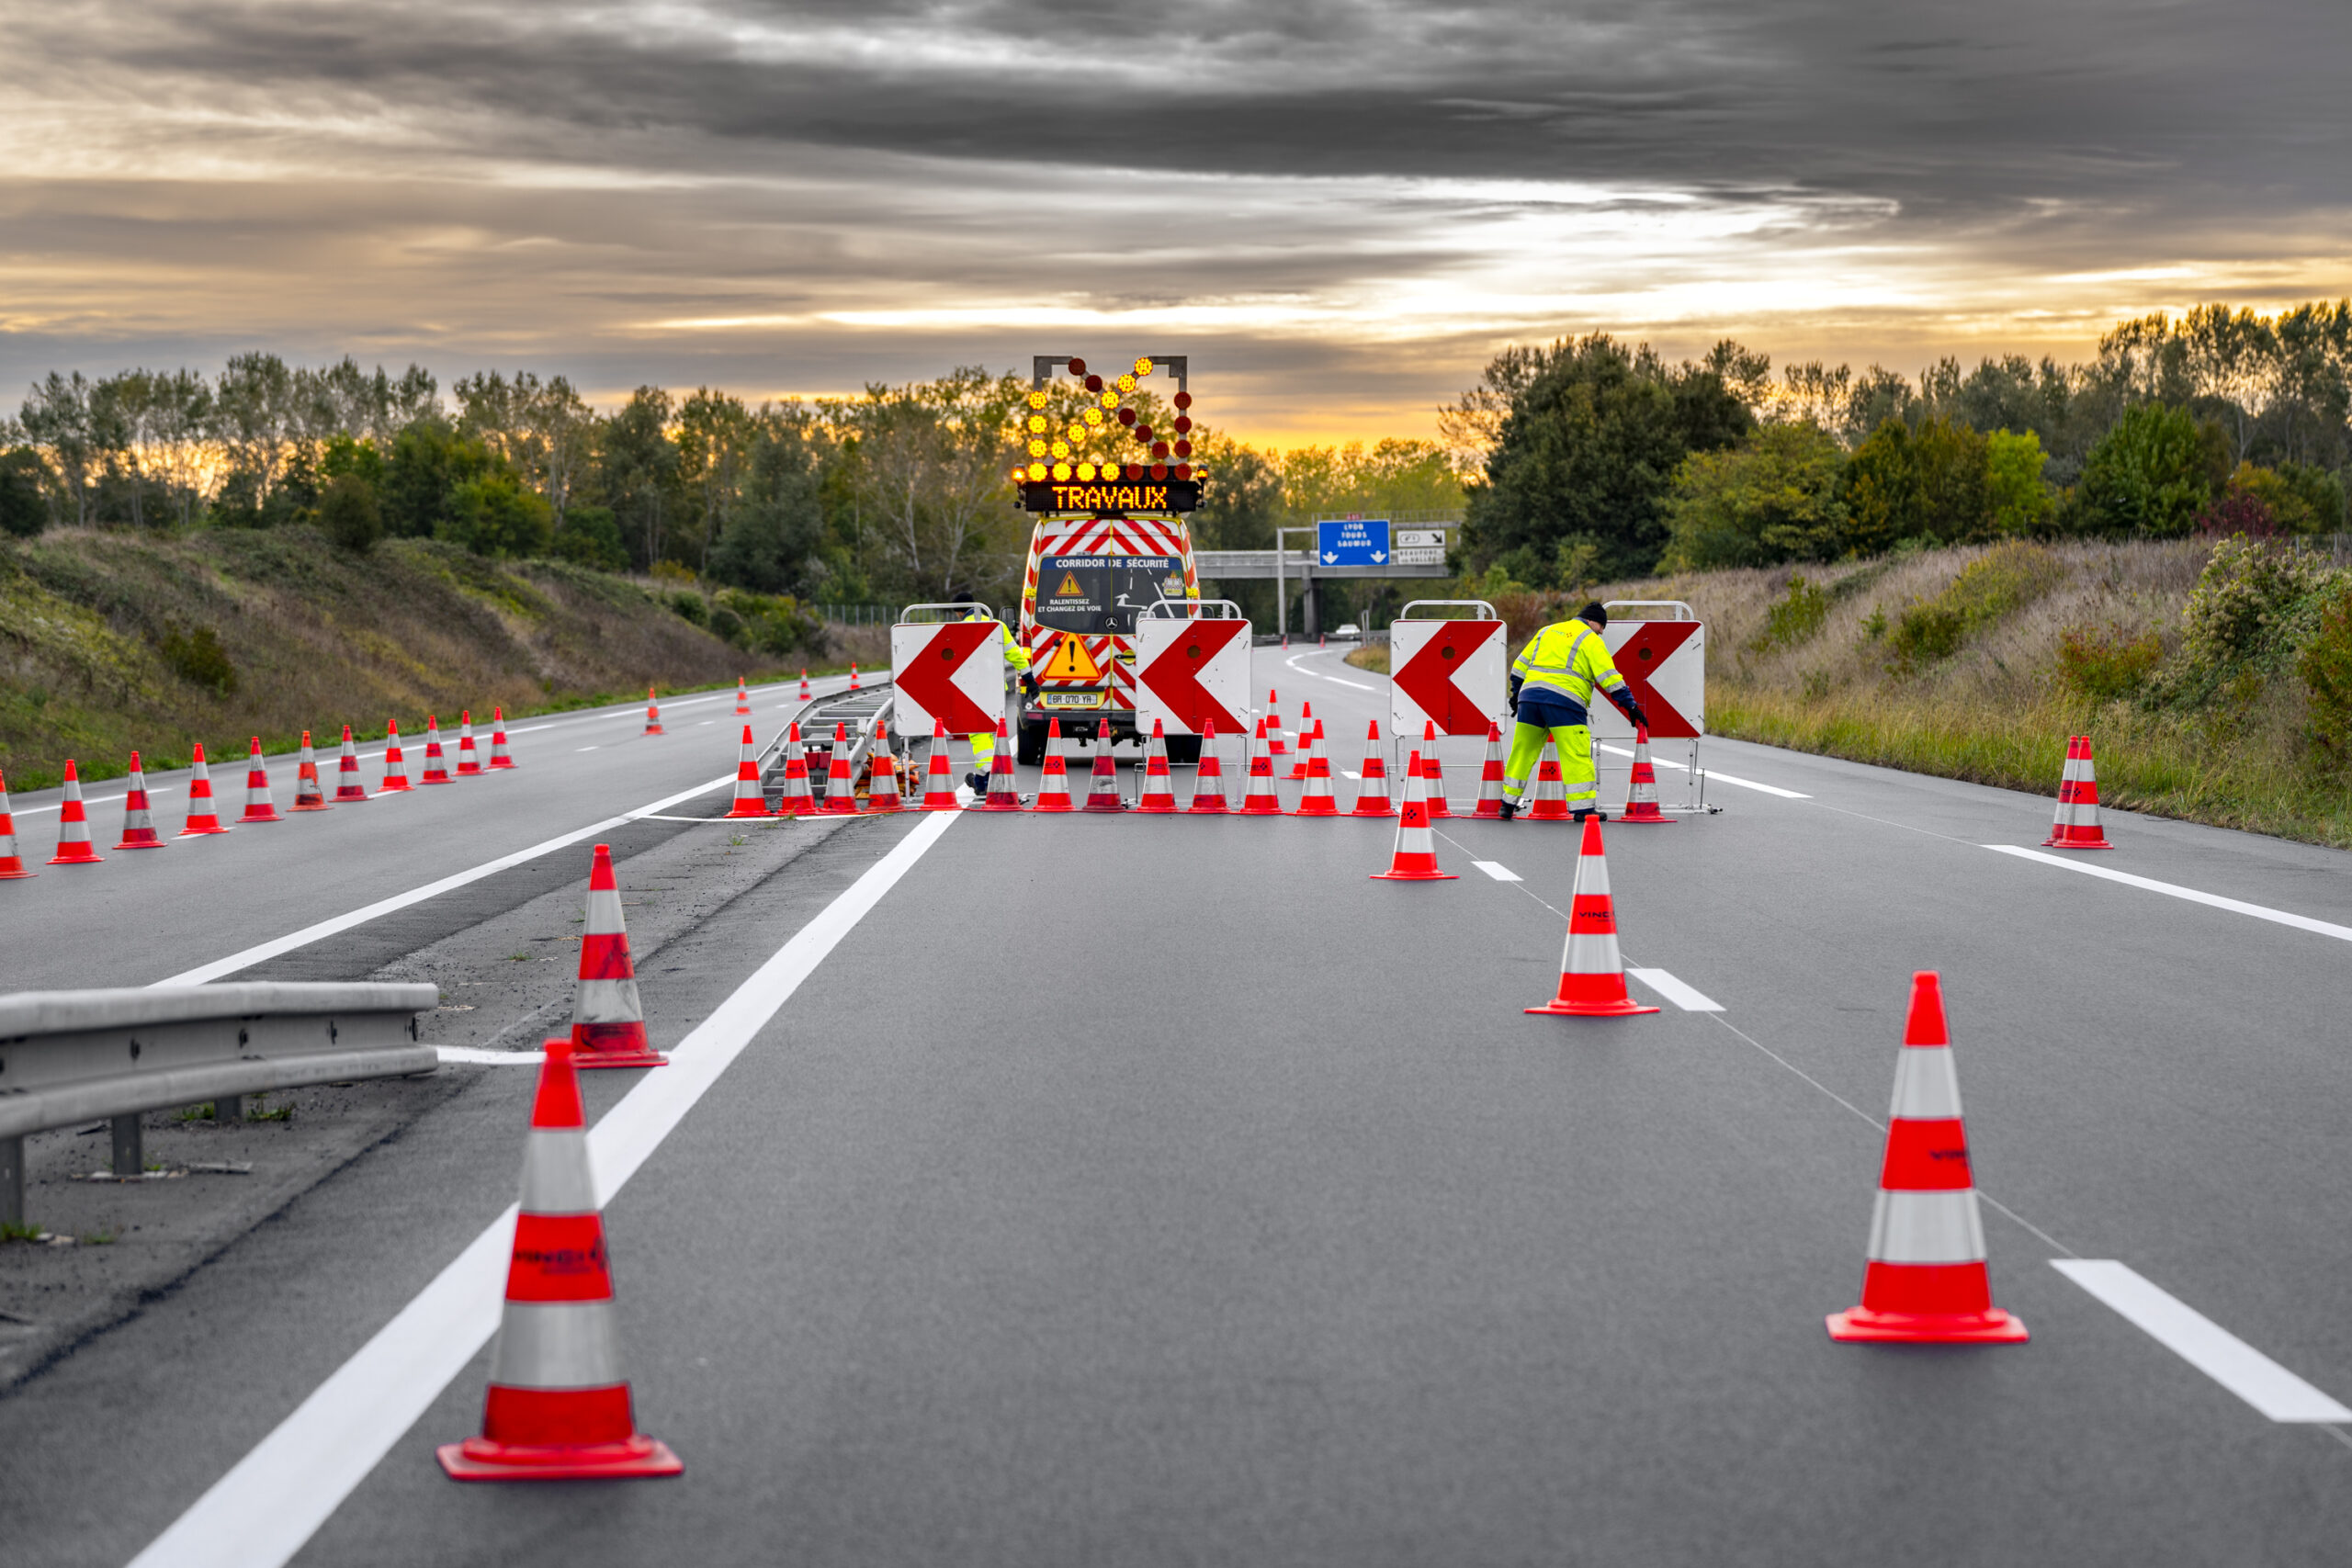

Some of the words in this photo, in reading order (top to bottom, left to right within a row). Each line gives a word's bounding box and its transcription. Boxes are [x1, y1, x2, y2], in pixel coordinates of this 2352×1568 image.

[1052, 486, 1167, 509] TRAVAUX
[1338, 539, 1372, 547] SAUMUR
[1056, 558, 1105, 569] CORRIDOR
[1108, 558, 1122, 568] DE
[1126, 557, 1170, 569] SÉCURITÉ
